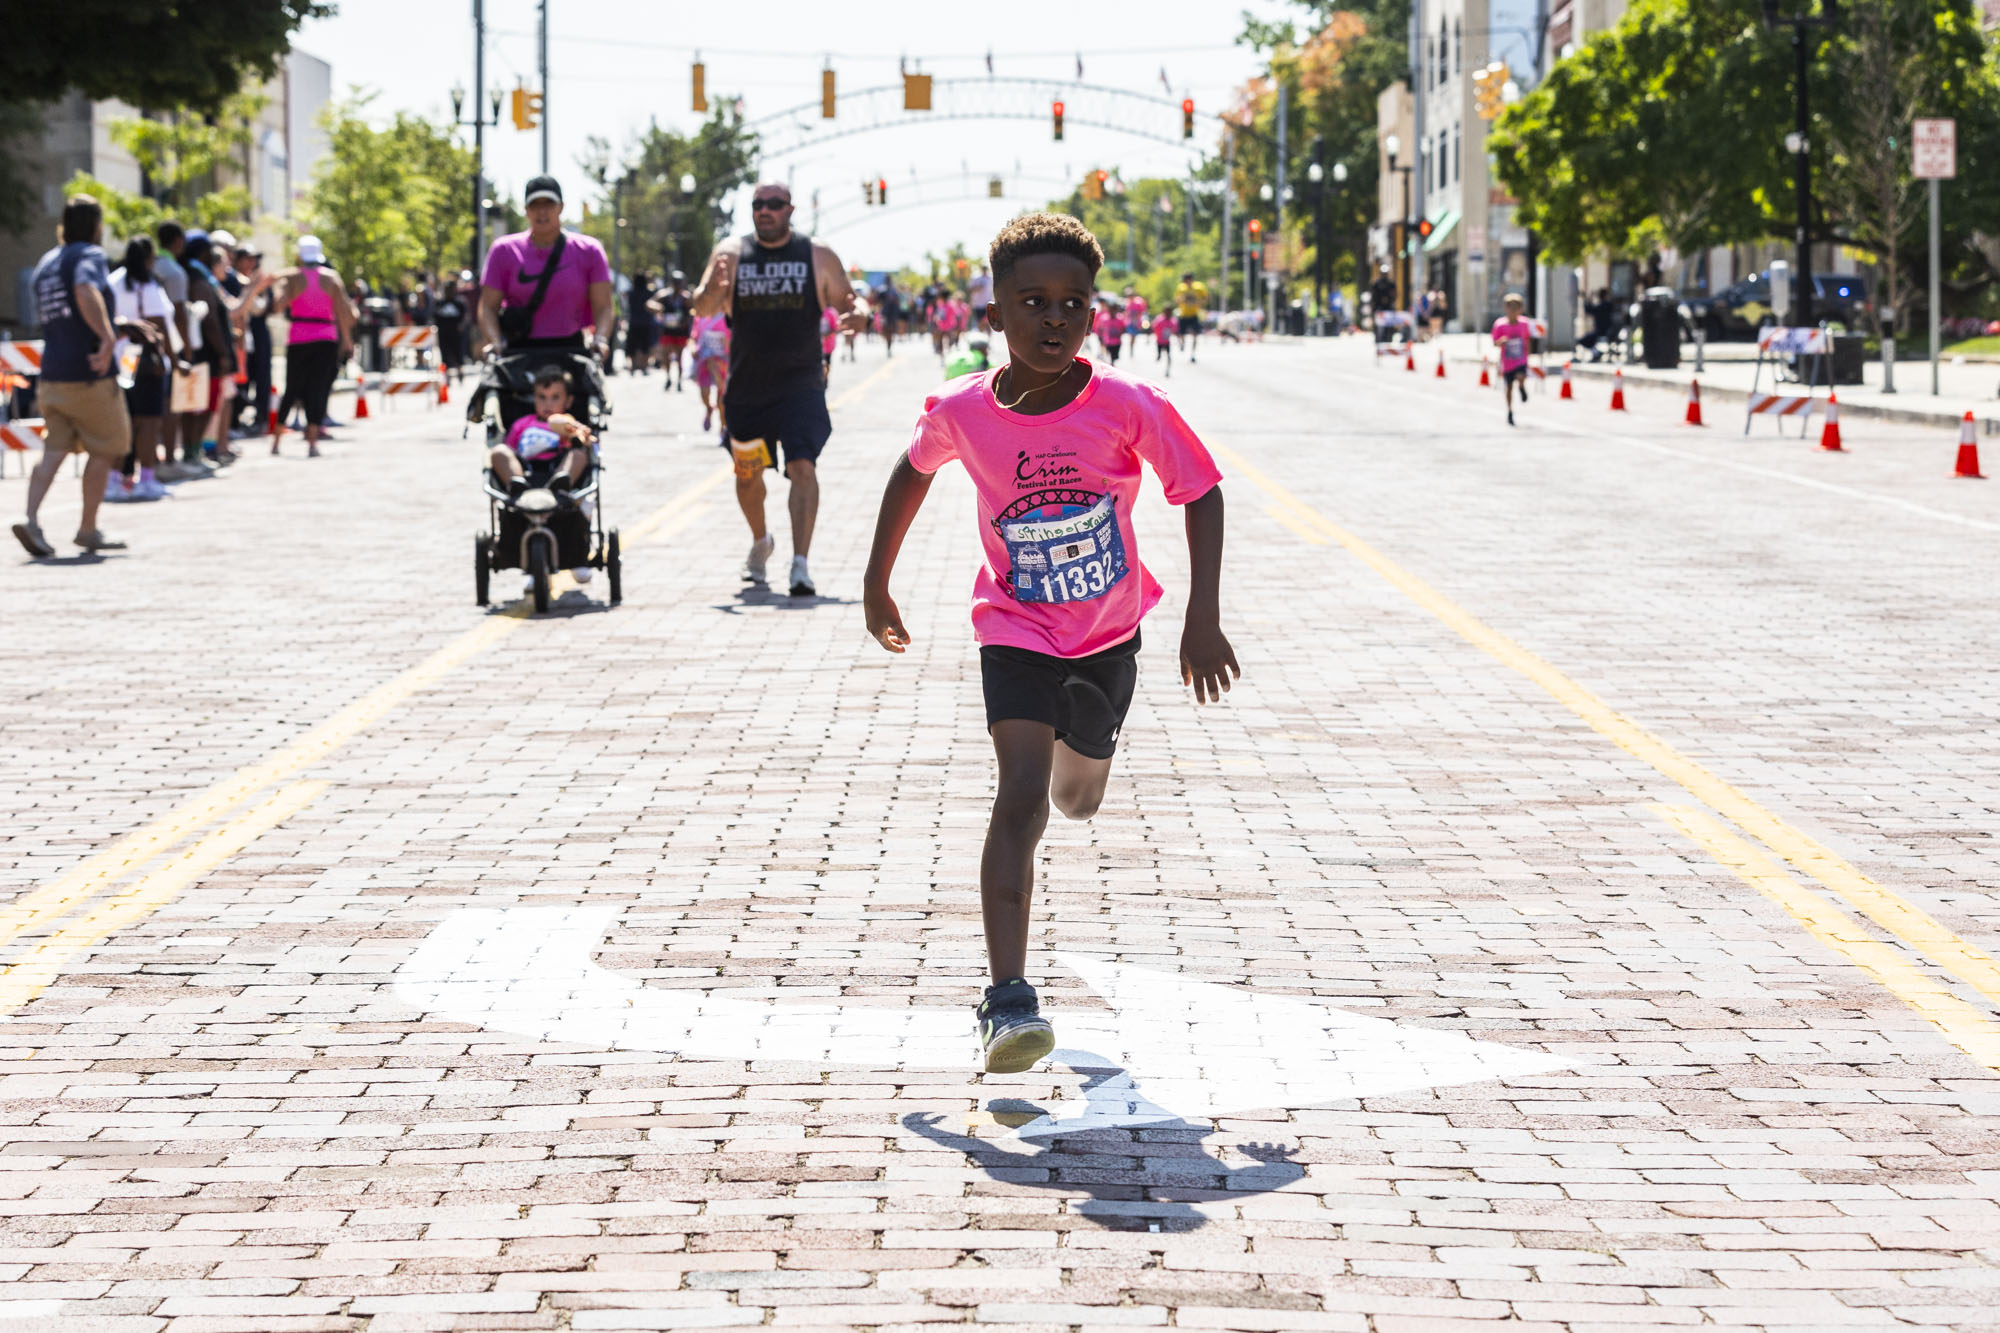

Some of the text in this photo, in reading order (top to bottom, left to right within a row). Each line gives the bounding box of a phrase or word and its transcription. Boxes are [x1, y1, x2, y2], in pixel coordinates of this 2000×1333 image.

[738, 261, 808, 279] BLOOD
[738, 279, 806, 296] SWEAT
[1012, 451, 1078, 485] Crim
[1017, 477, 1082, 490] Festival of Races
[1040, 550, 1115, 603] 11332
